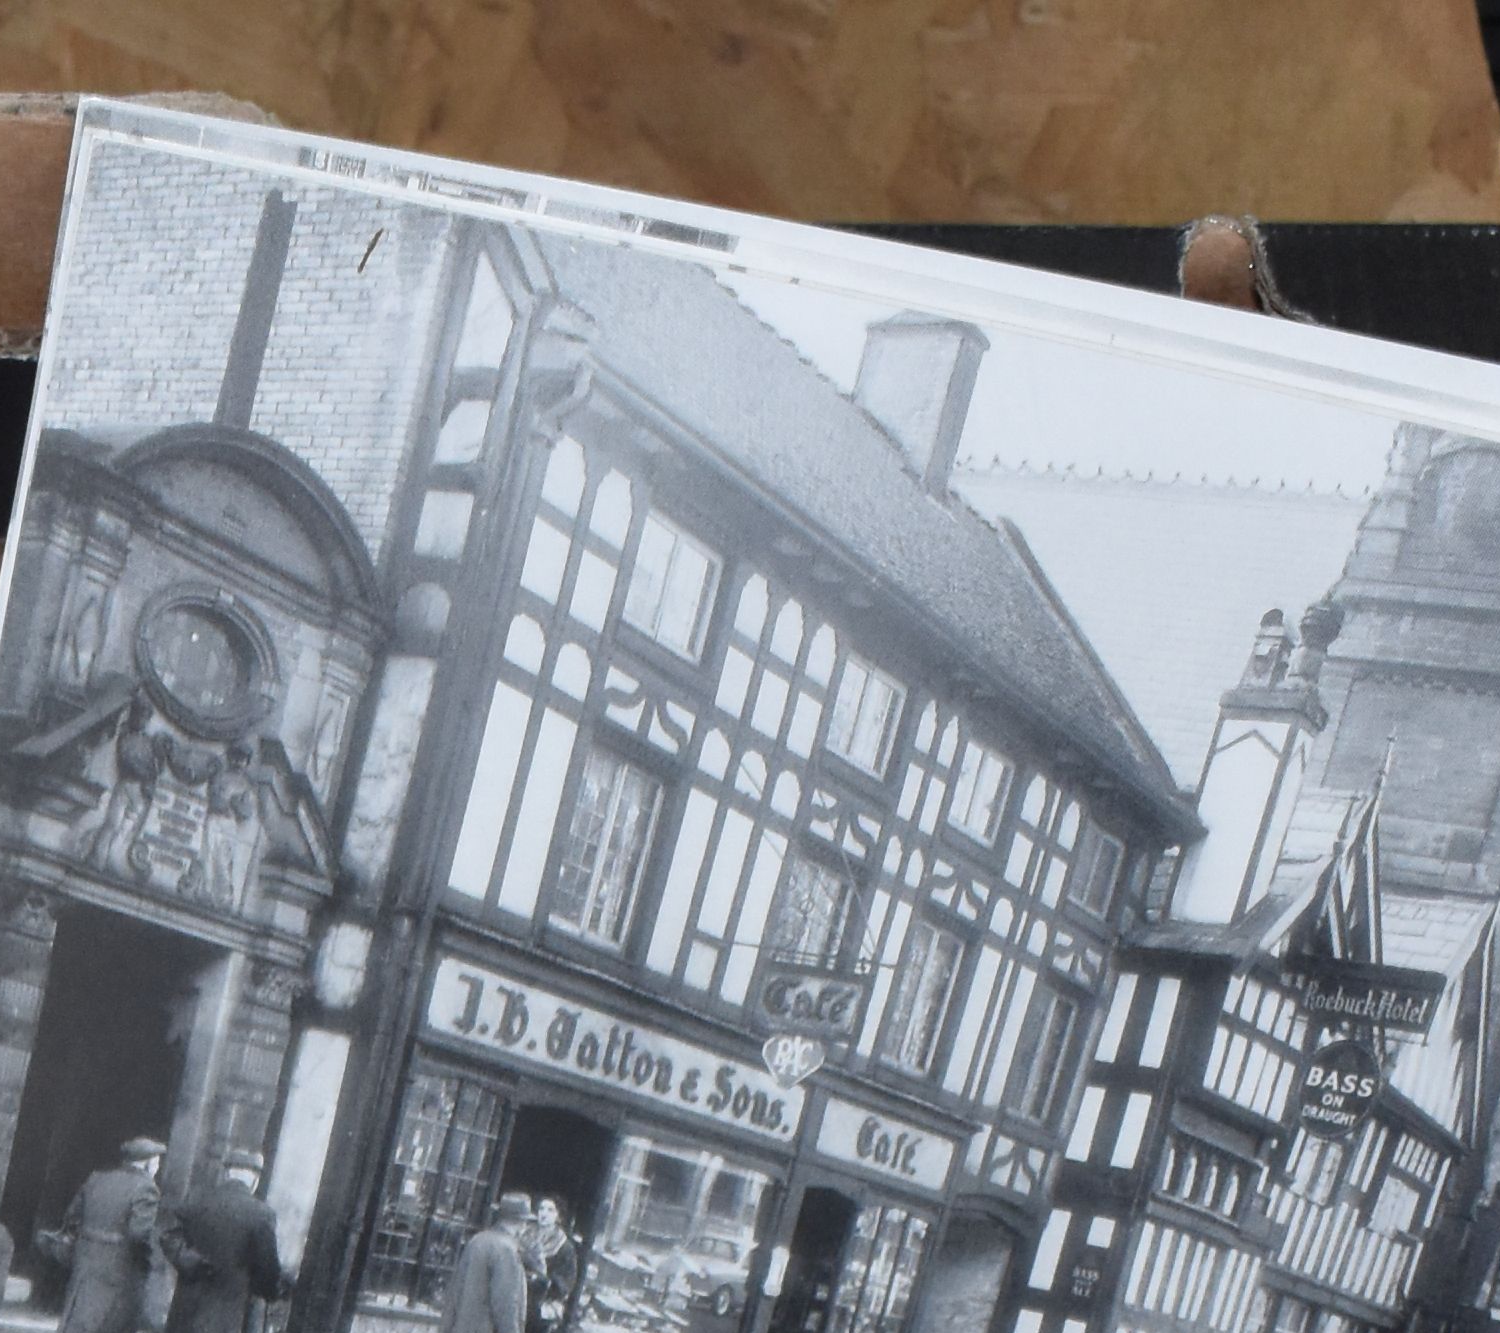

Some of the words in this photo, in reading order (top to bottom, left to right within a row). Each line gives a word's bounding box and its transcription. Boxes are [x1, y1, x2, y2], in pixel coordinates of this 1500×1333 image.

[1303, 979, 1377, 1018] Roebuck
[1376, 989, 1429, 1025] Hotel
[1305, 1065, 1375, 1098] BASS
[1321, 1092, 1345, 1109] ON
[1301, 1104, 1357, 1127] DRAUGHT
